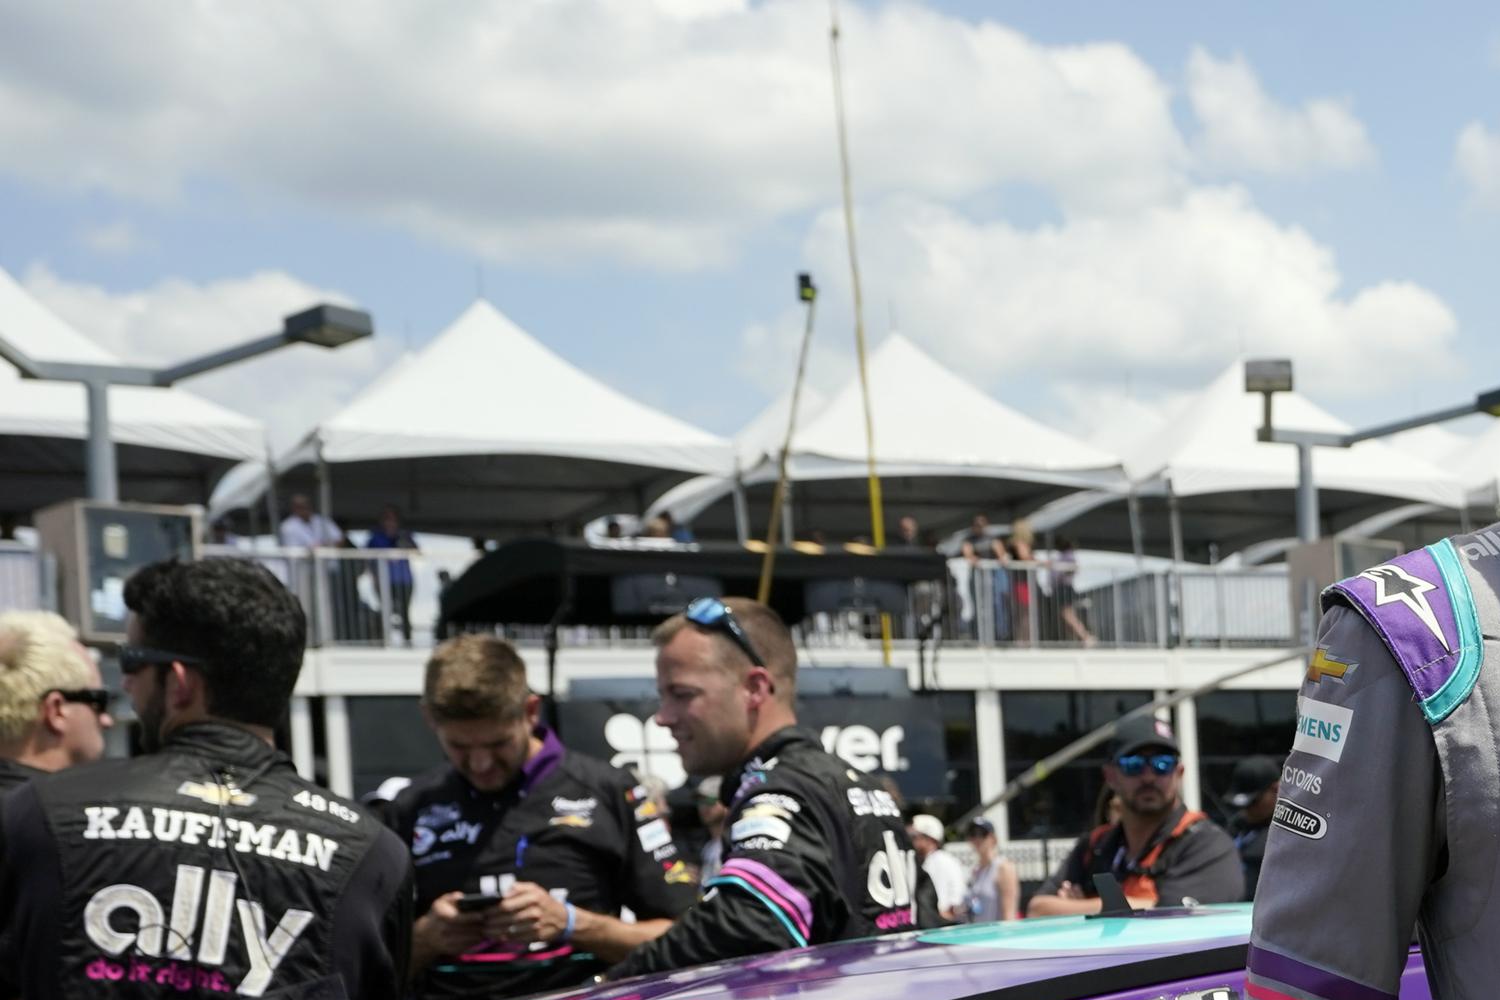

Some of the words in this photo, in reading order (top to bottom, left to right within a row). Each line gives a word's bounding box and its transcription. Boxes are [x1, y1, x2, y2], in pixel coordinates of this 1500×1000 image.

[1297, 715, 1342, 742] MENS
[84, 806, 339, 872] KAUFFMAN
[84, 864, 314, 997] ally
[85, 960, 122, 981] do
[129, 960, 150, 982] it
[155, 963, 231, 991] right.
